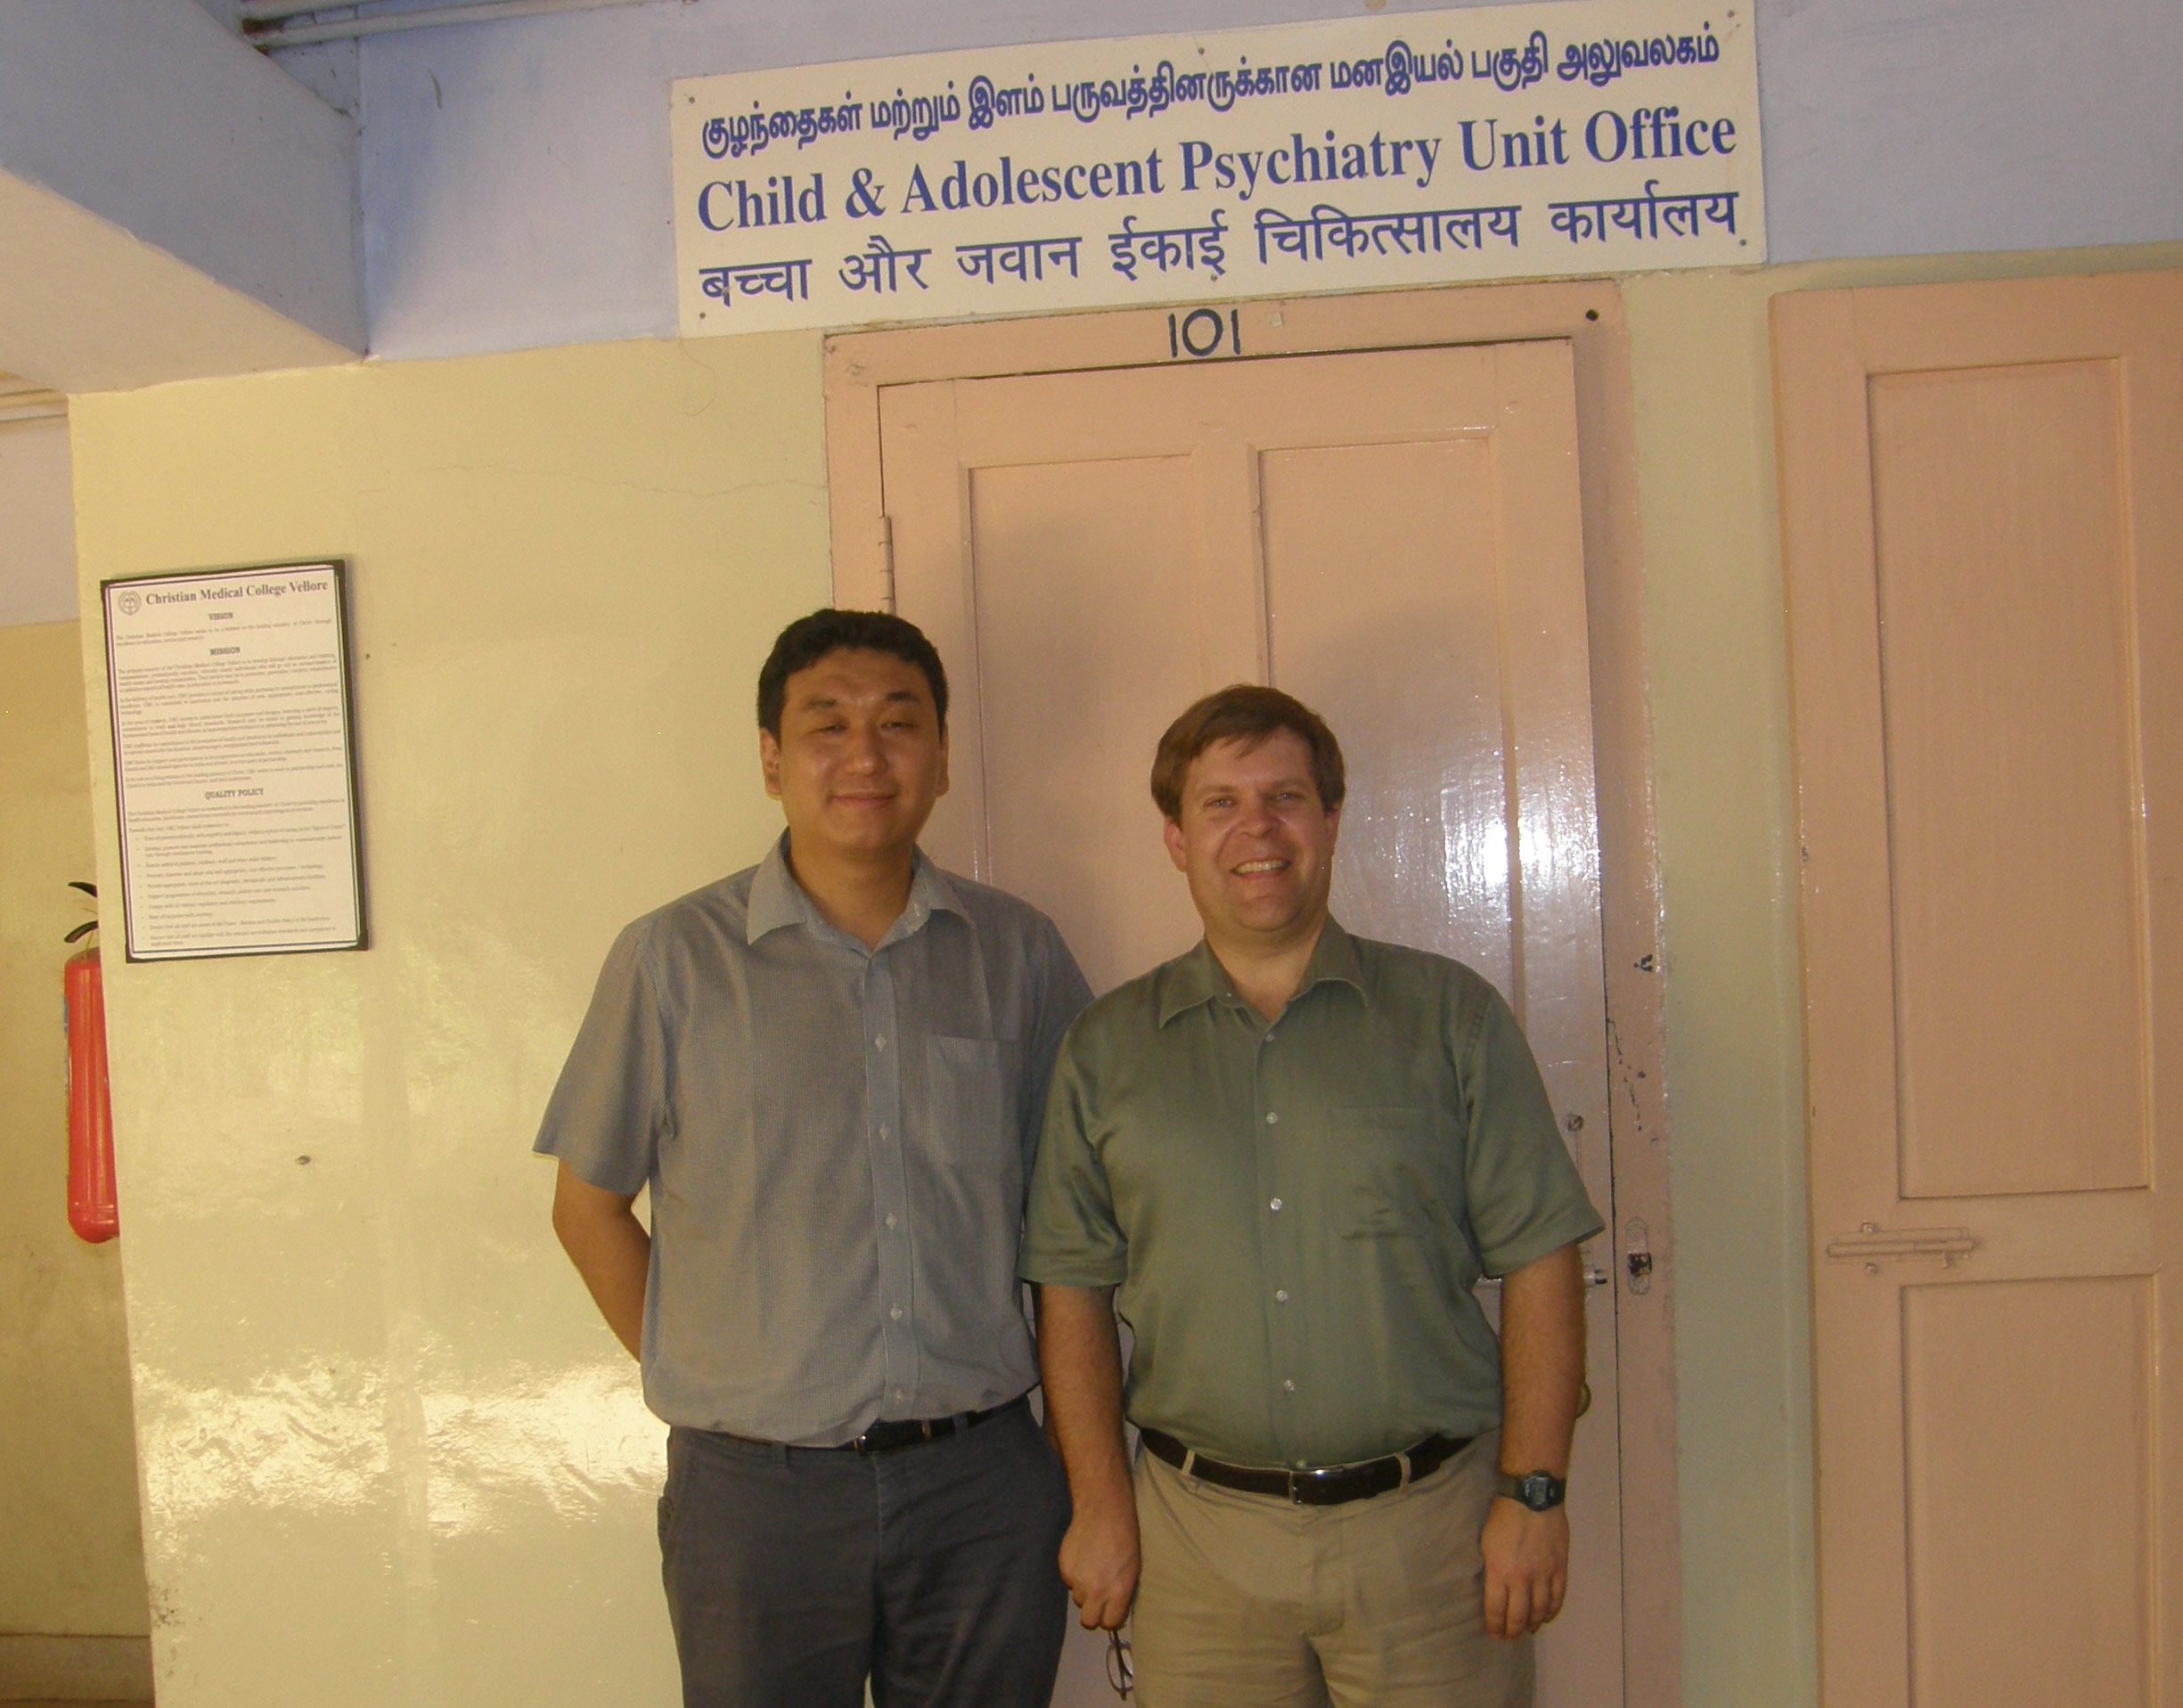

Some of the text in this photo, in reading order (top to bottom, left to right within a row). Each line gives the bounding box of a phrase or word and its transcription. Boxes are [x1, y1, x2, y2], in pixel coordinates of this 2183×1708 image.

[702, 21, 1720, 159] குழந்தைகள் மற்றும் இளம் பருவத்தினருக்கான மனஇயல் பகுதி அலுவலகம்
[698, 106, 1737, 232] Child & Adolescent Psychiatry Unit Office
[699, 179, 1740, 307] बच्चा और जवान ईकाई चिकित्सालय कार्यालय
[1167, 308, 1240, 358] 101
[145, 579, 329, 606] Christian Medical College Vellore
[210, 646, 241, 656] MISSION
[205, 788, 264, 800] QUALITY POLICY
